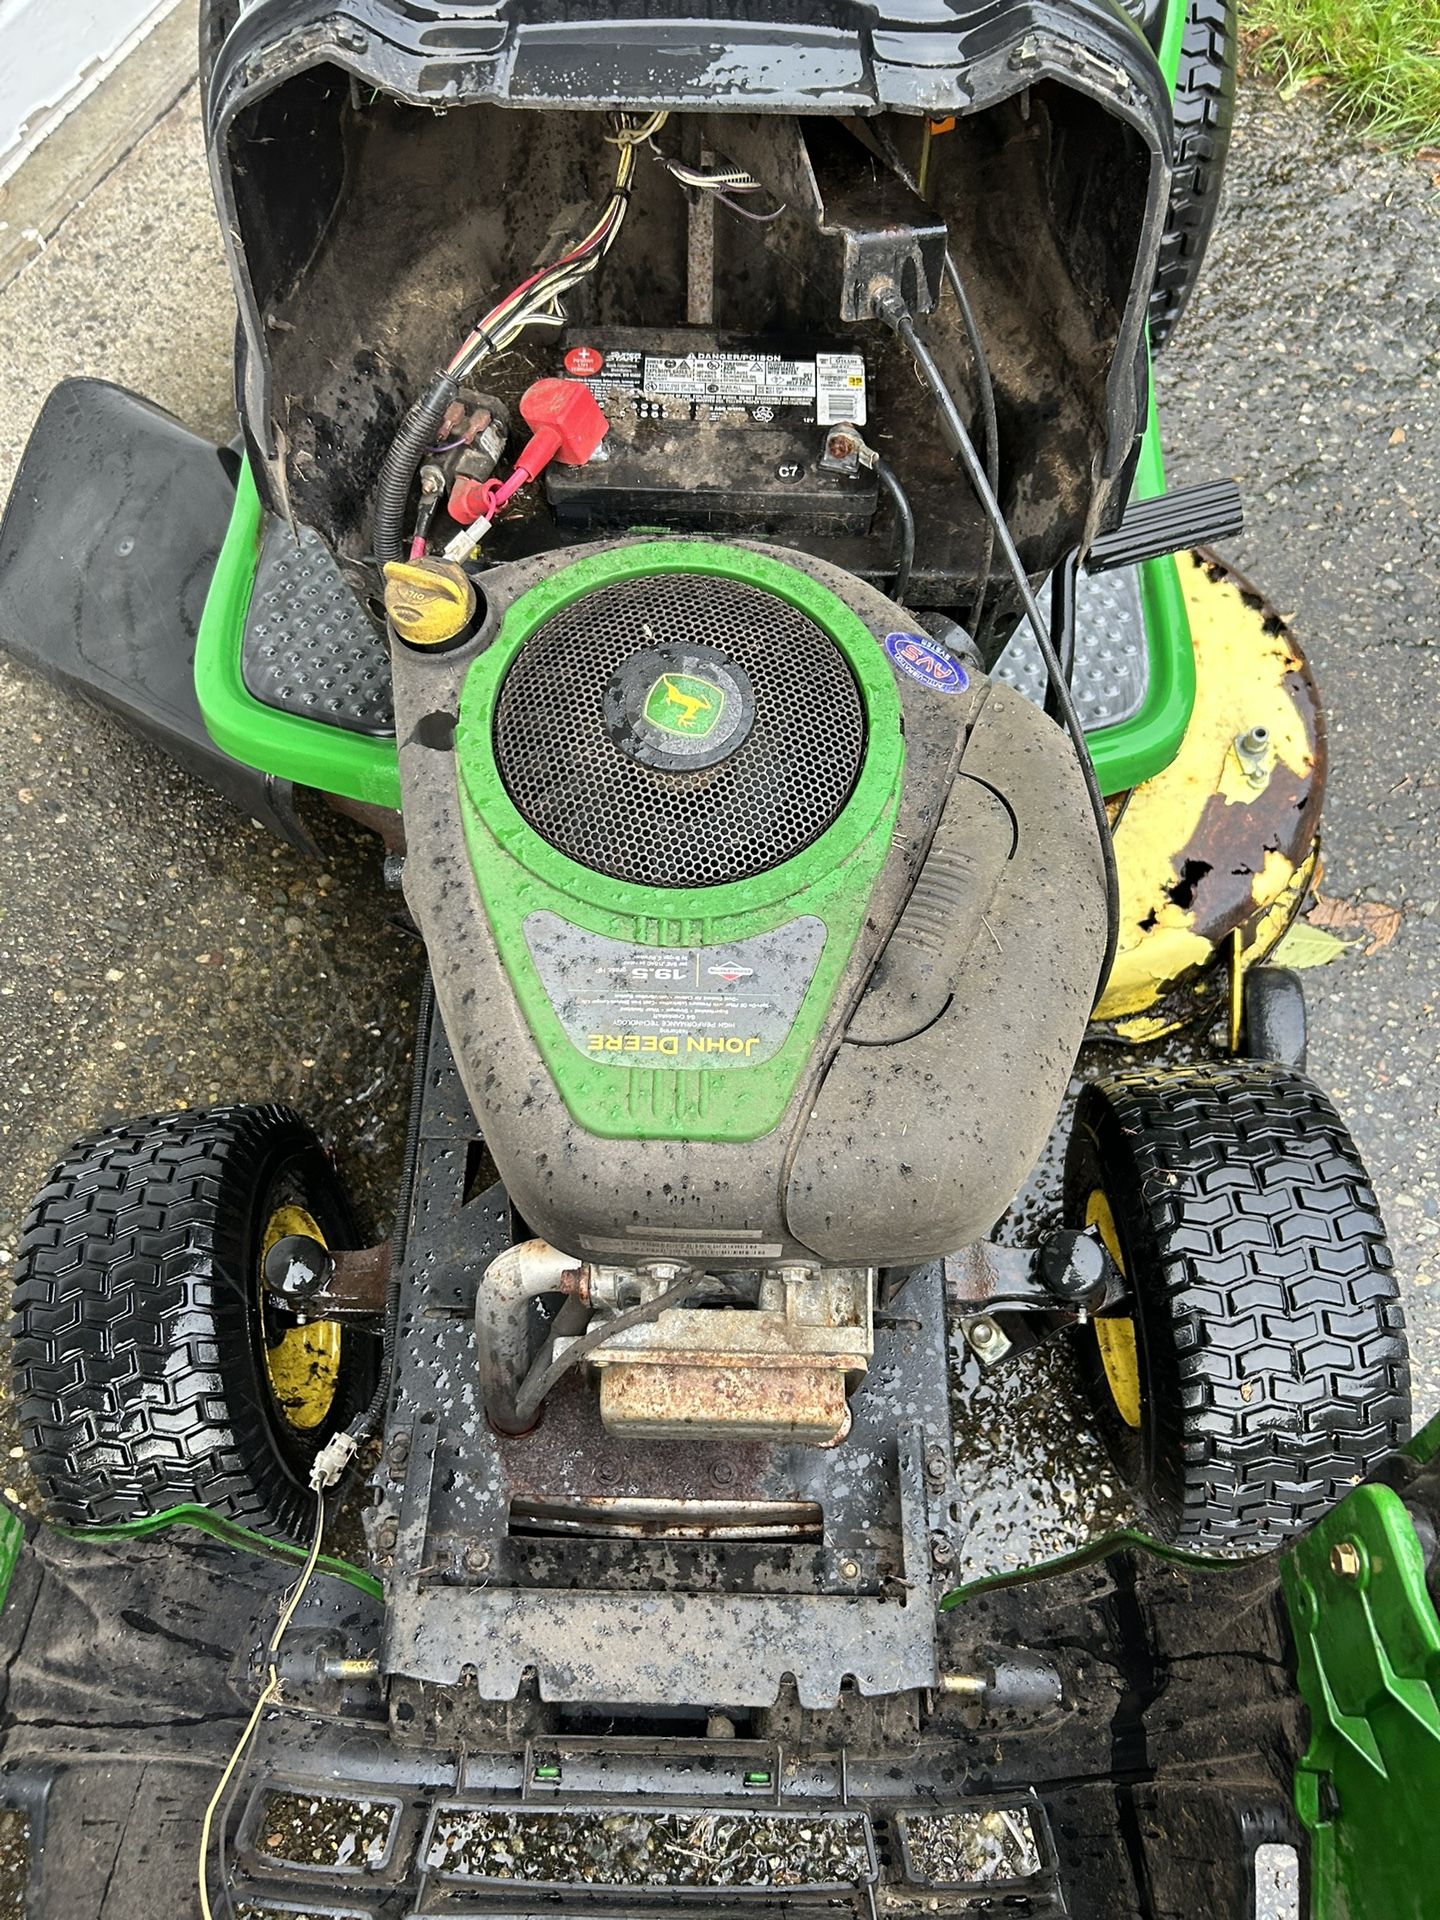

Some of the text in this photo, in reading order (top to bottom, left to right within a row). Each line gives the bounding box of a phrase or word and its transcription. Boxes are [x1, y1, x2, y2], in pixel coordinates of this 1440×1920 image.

[697, 352, 781, 362] DANGER/POISON
[778, 464, 798, 478] C7
[408, 590, 425, 600] OIL
[920, 639, 951, 660] SYSTEM
[900, 644, 953, 680] AVS
[631, 968, 687, 980] 19.5
[587, 1034, 760, 1057] JOHN DEERE
